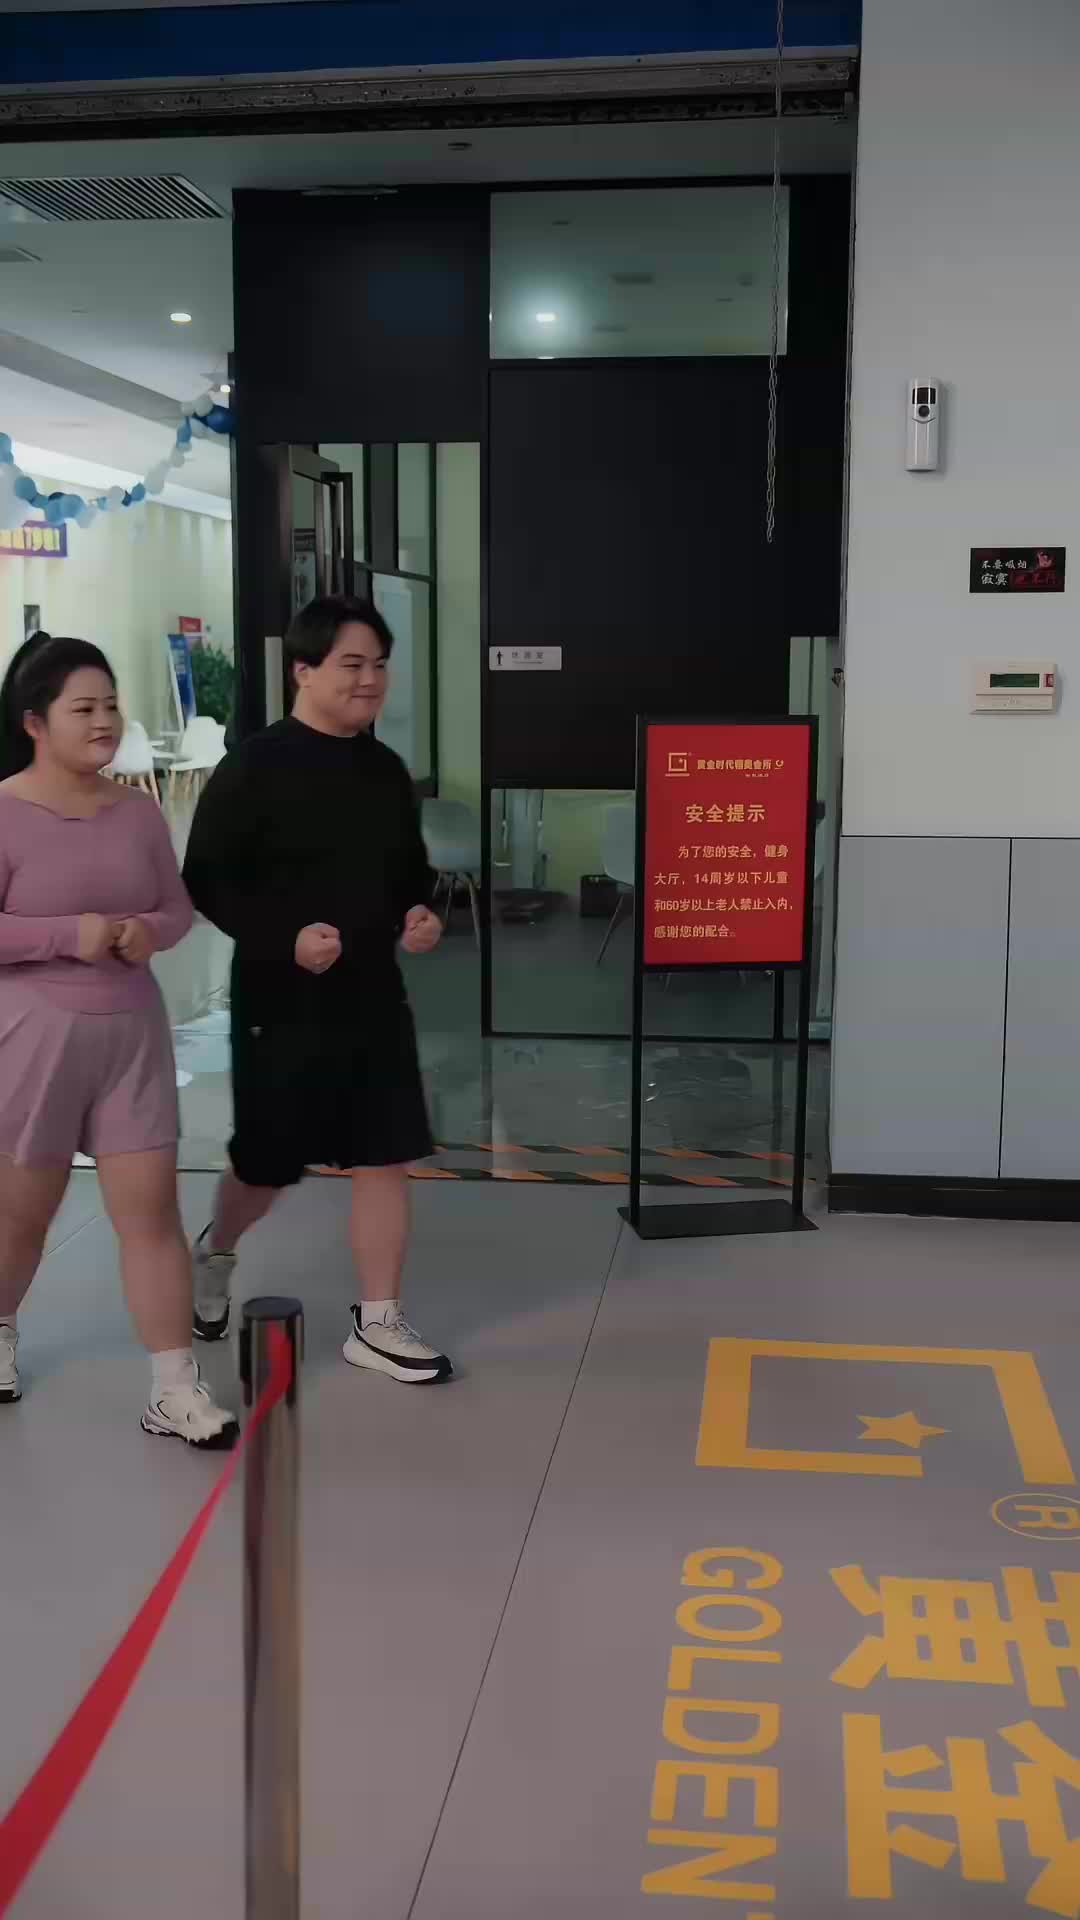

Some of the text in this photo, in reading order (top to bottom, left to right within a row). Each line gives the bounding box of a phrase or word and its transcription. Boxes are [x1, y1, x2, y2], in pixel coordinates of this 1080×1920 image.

[685, 804, 765, 823] 安全提示
[678, 844, 788, 858] 为了您的安全，健身
[654, 871, 788, 885] 大厅，14周岁以下儿童
[654, 897, 793, 912] 和60岁以上老人禁止入内，
[654, 925, 735, 938] 感谢您的配合。
[640, 1546, 783, 1902] GOLDEN
[828, 1564, 1080, 1919] 黄金
